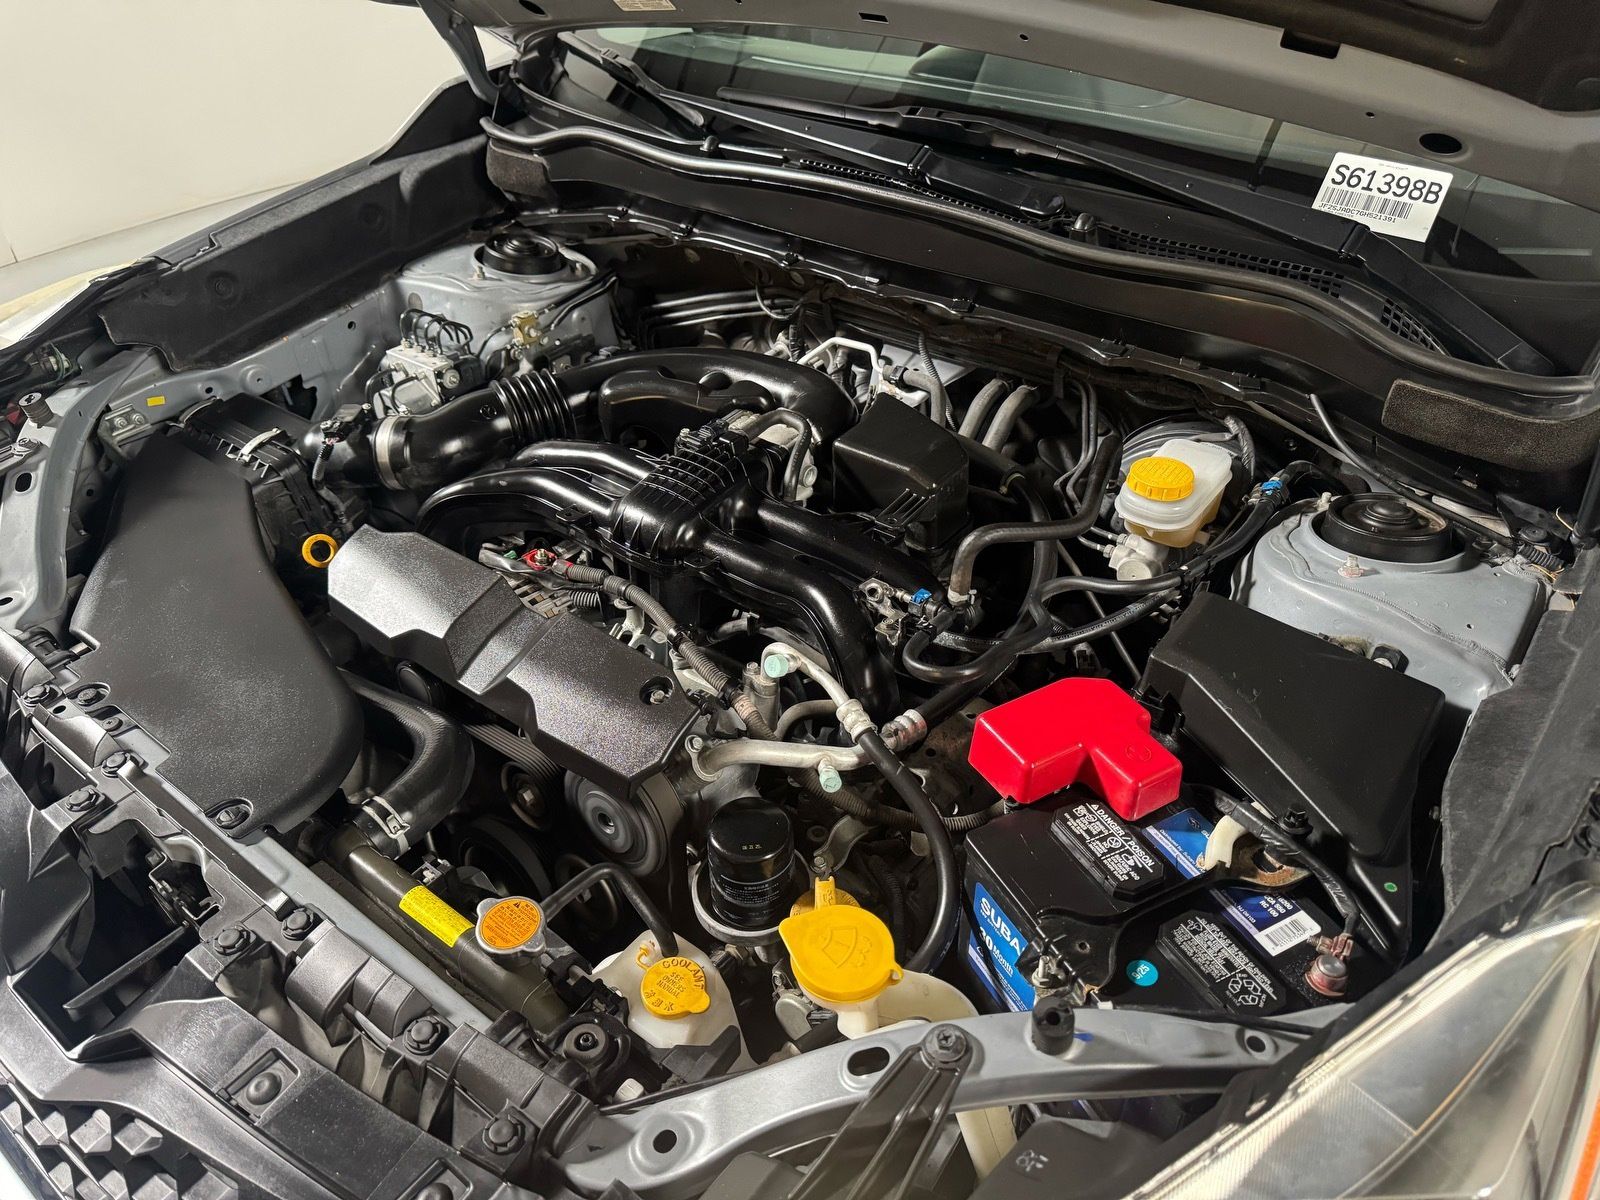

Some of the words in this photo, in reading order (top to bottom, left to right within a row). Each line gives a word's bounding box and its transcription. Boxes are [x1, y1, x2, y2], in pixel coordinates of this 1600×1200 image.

[1331, 164, 1443, 205] S61398B
[1097, 809, 1125, 837] DANGER
[1127, 840, 1155, 867] POISON
[1259, 900, 1269, 908] RC
[1267, 907, 1279, 918] 100
[981, 897, 1025, 957] SUBA
[662, 958, 704, 990] COOLANT
[992, 945, 1014, 976] Month
[1131, 964, 1150, 980] 9/25
